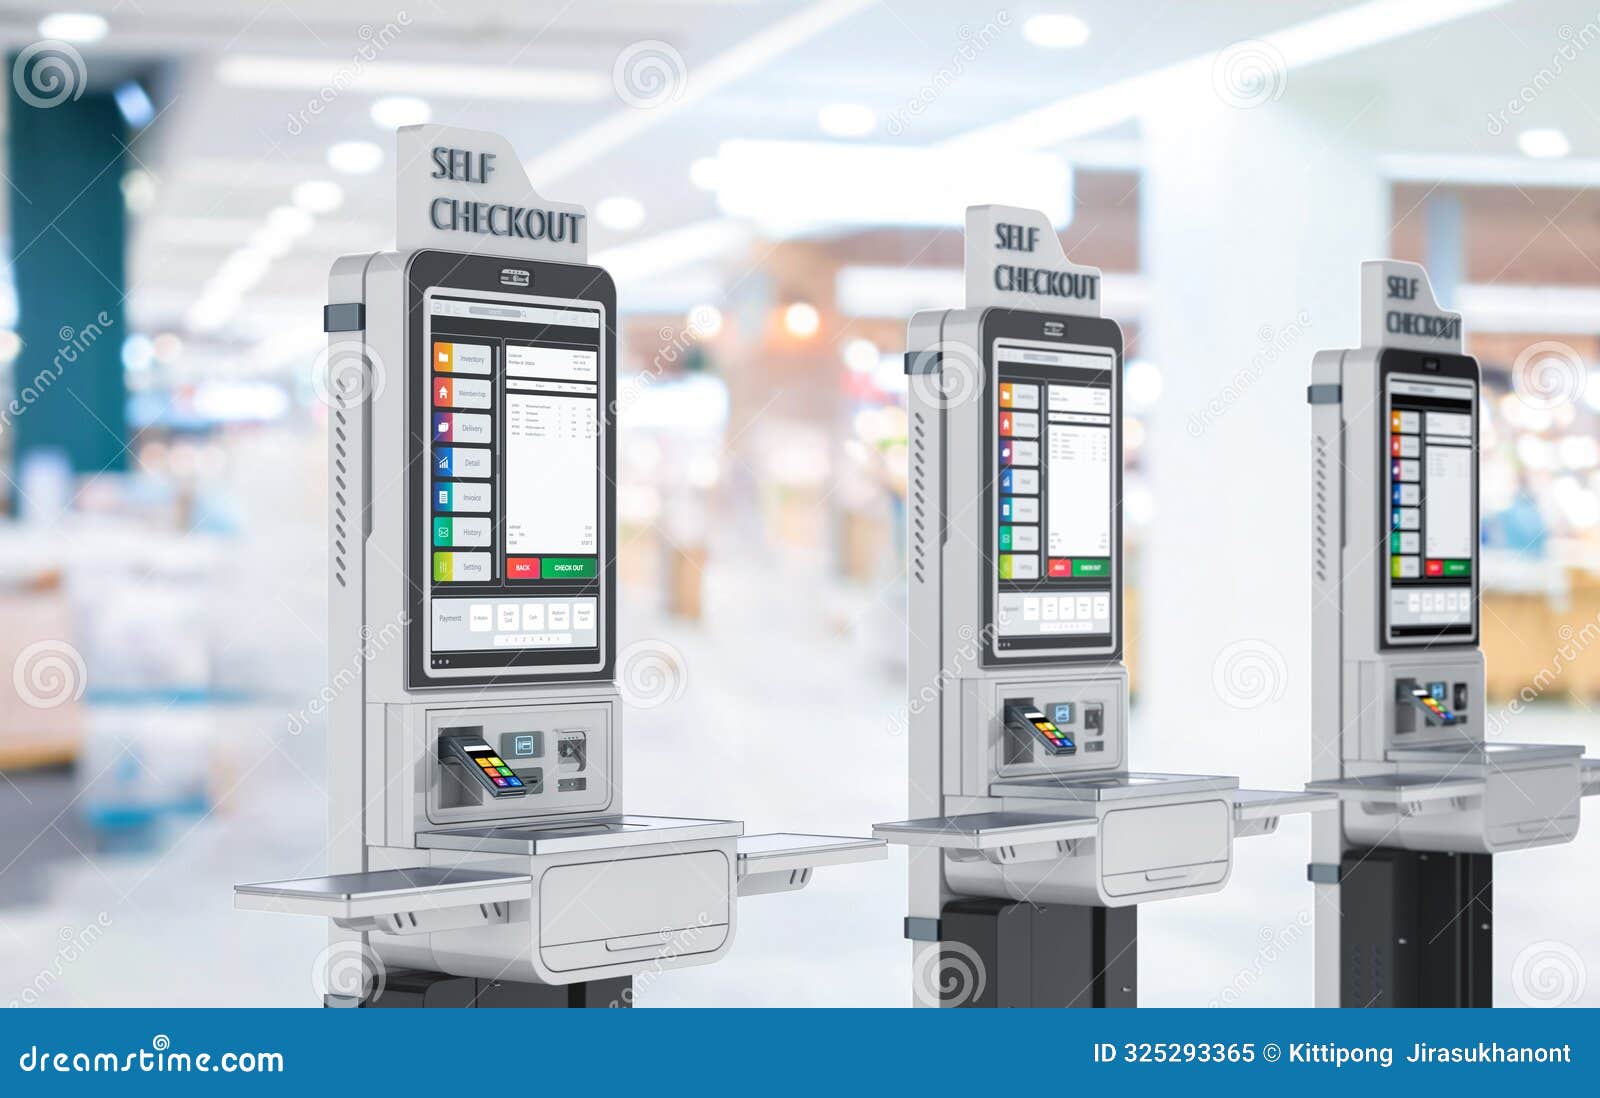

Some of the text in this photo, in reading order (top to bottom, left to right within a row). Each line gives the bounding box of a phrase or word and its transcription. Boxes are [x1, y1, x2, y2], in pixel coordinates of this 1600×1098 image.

[431, 146, 497, 184] SELF
[430, 197, 586, 244] CHECKOUT
[994, 222, 1040, 252] SELF
[994, 263, 1101, 301] CHECKOUT
[1386, 275, 1420, 300] SELF
[1386, 310, 1462, 340] CHECKOUT
[461, 424, 483, 434] Delivery
[464, 458, 481, 468] Detail
[463, 493, 482, 502] Invoice
[463, 527, 481, 537] History
[463, 563, 482, 572] Setting
[439, 614, 462, 623] Payment
